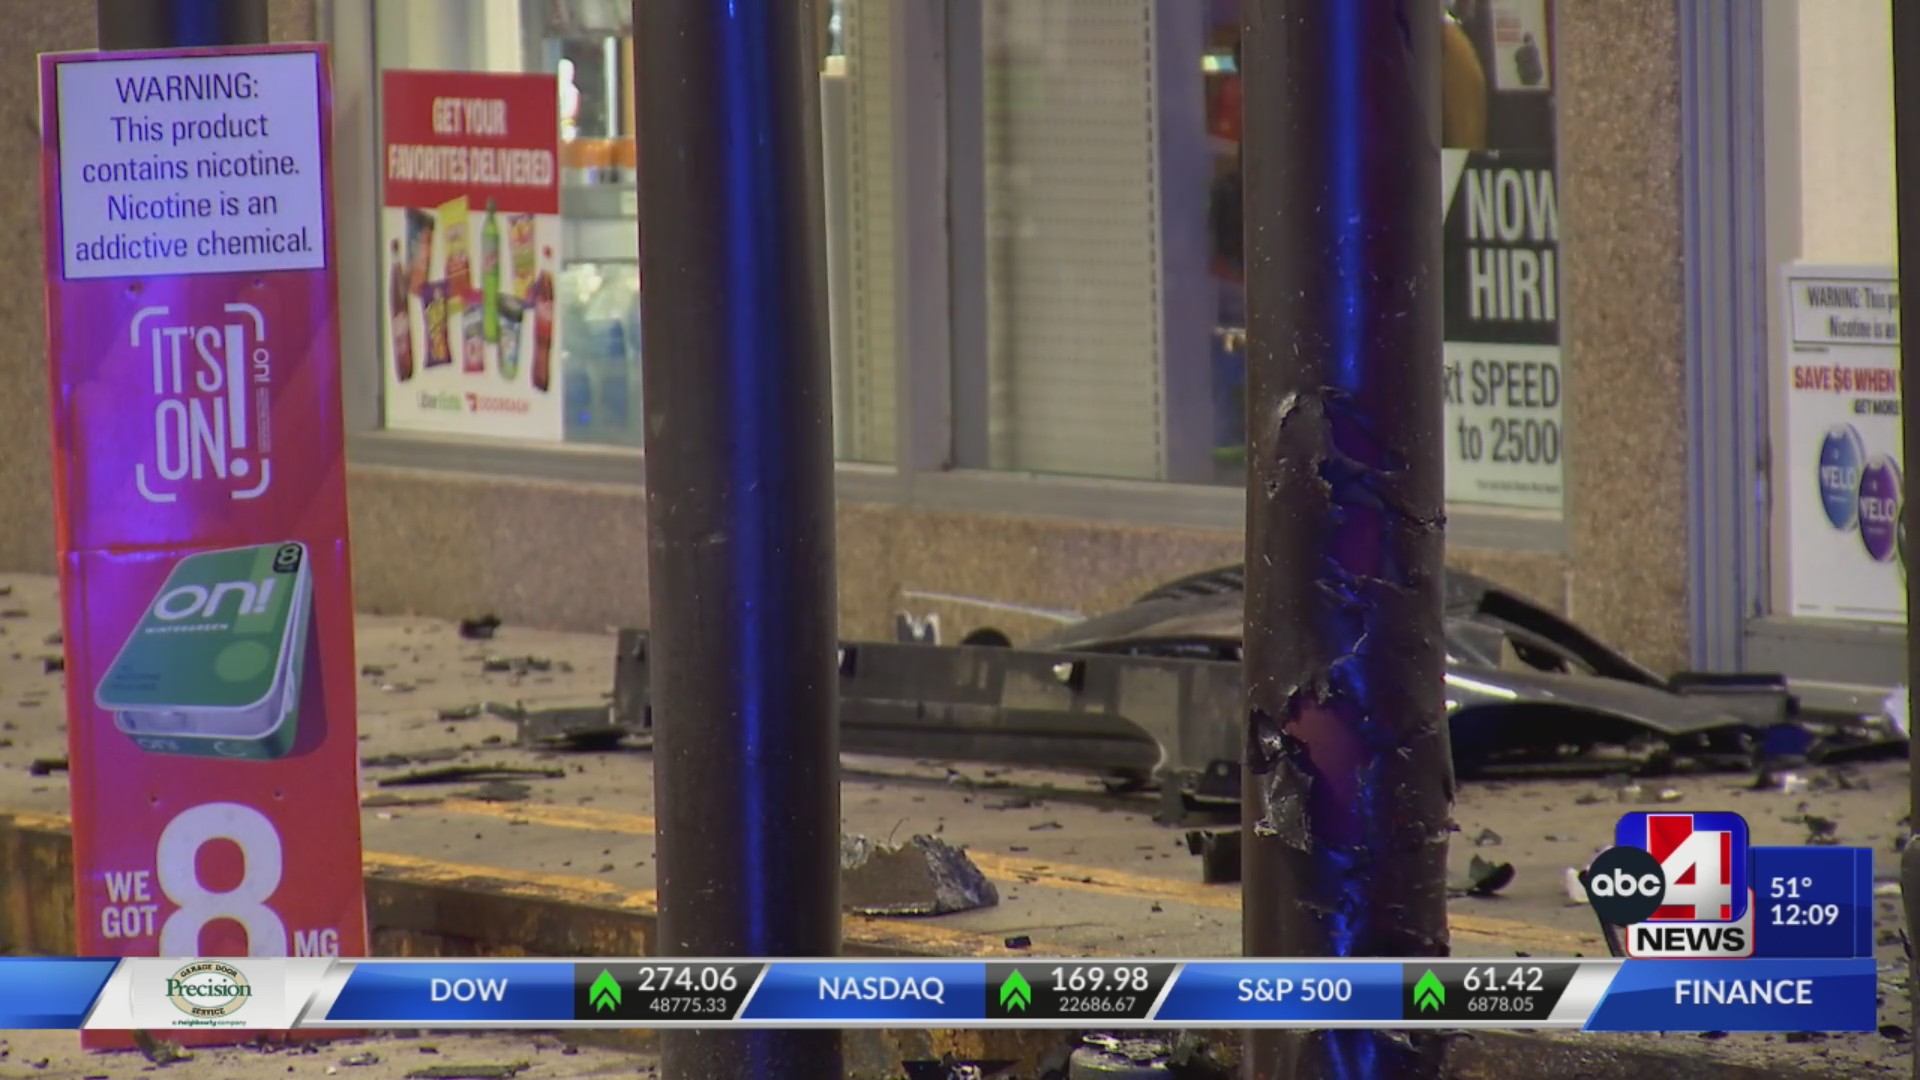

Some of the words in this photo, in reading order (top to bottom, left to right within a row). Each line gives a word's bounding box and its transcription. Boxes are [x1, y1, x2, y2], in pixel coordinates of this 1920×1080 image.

[116, 72, 258, 104] WARNING:
[110, 115, 163, 143] This
[172, 112, 268, 147] product
[433, 97, 462, 135] GET
[463, 97, 507, 135] YOUR
[83, 154, 188, 183] contains
[197, 150, 300, 178] nicotine.
[388, 144, 468, 184] FAVORITES
[470, 147, 554, 186] DELIVERED
[107, 192, 211, 221] Nicotine
[220, 190, 239, 216] is
[248, 194, 277, 215] an
[1465, 168, 1559, 242] NOW
[76, 232, 188, 261] addictive
[197, 226, 312, 256] chemical.
[1469, 248, 1556, 320] HIRI
[1829, 314, 1872, 338] Nicotine
[152, 325, 222, 394] IT'S
[1471, 359, 1560, 408] SPEED
[1794, 365, 1831, 390] SAVE
[1833, 361, 1852, 395] $6
[1854, 367, 1896, 392] WHEN
[1458, 416, 1483, 461] to
[1490, 416, 1563, 465] 2500
[1860, 497, 1896, 521] VELO
[278, 545, 299, 566] 8
[154, 577, 276, 621] on!
[105, 871, 151, 903] WE
[101, 904, 158, 938] GOT
[294, 929, 339, 957] MG
